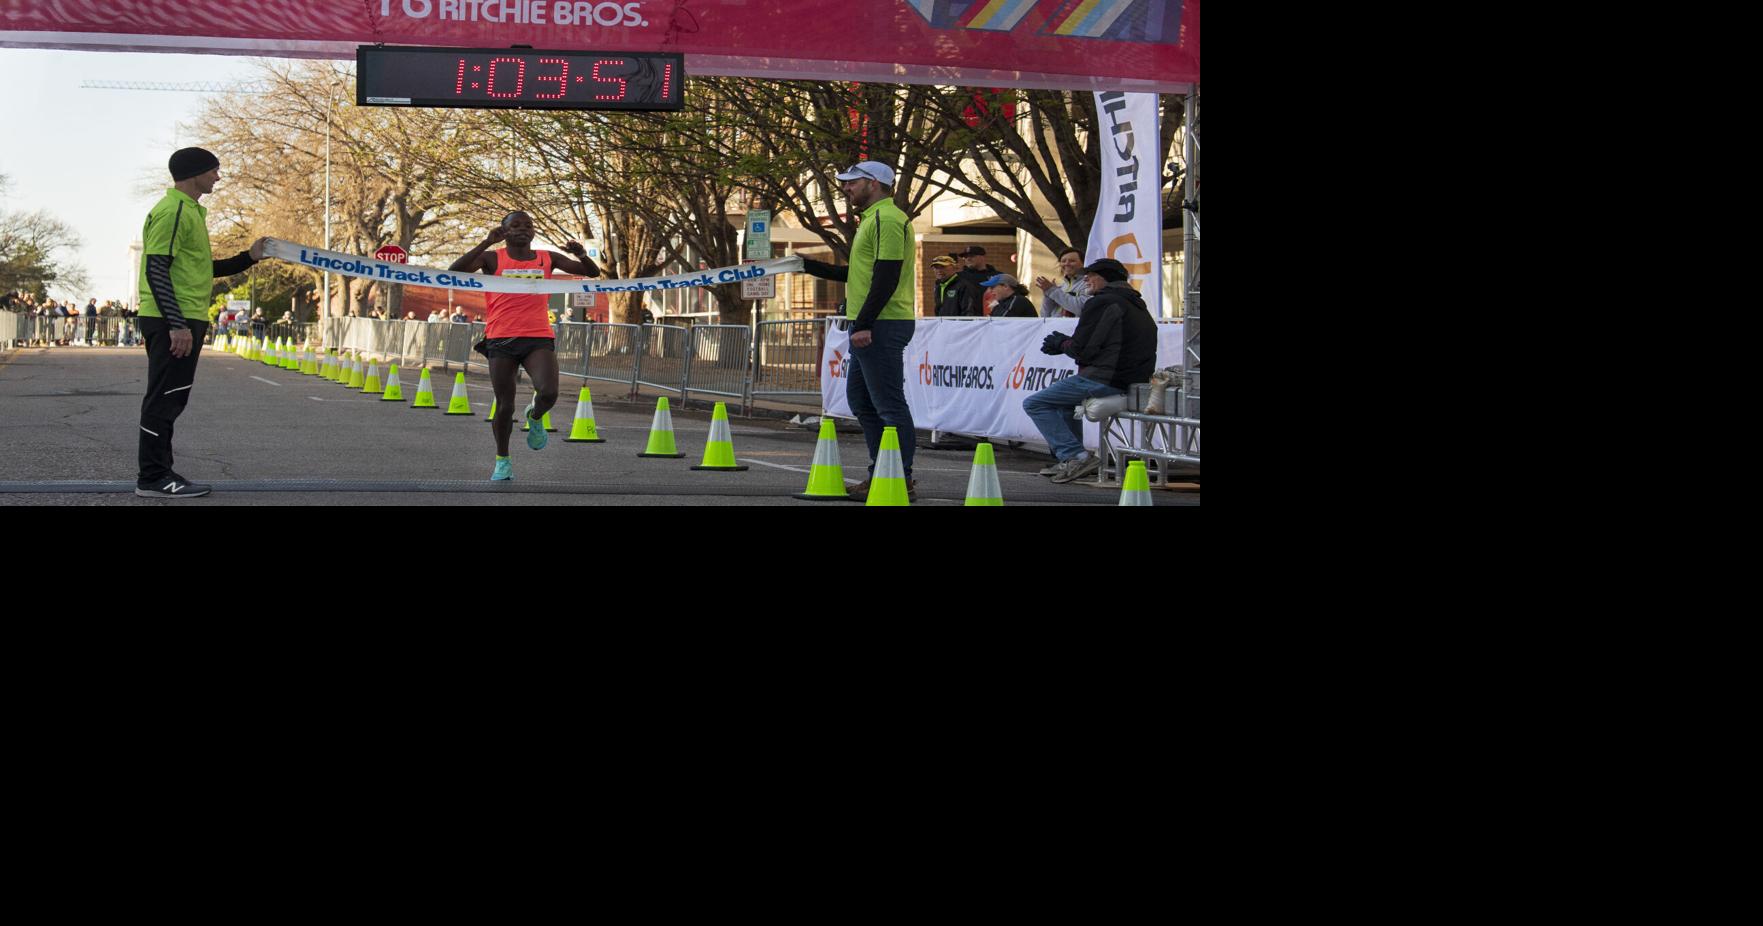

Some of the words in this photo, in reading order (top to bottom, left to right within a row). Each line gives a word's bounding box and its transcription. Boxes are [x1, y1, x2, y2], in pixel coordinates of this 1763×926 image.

[440, 0, 546, 24] RITCHIE
[554, 1, 649, 27] BROS.
[300, 249, 373, 276] Lincoln
[376, 264, 432, 284] Track
[436, 273, 483, 289] Club
[377, 252, 405, 263] STOP
[582, 282, 658, 293] Lincoln
[657, 274, 714, 290] Track
[718, 265, 766, 283] Club
